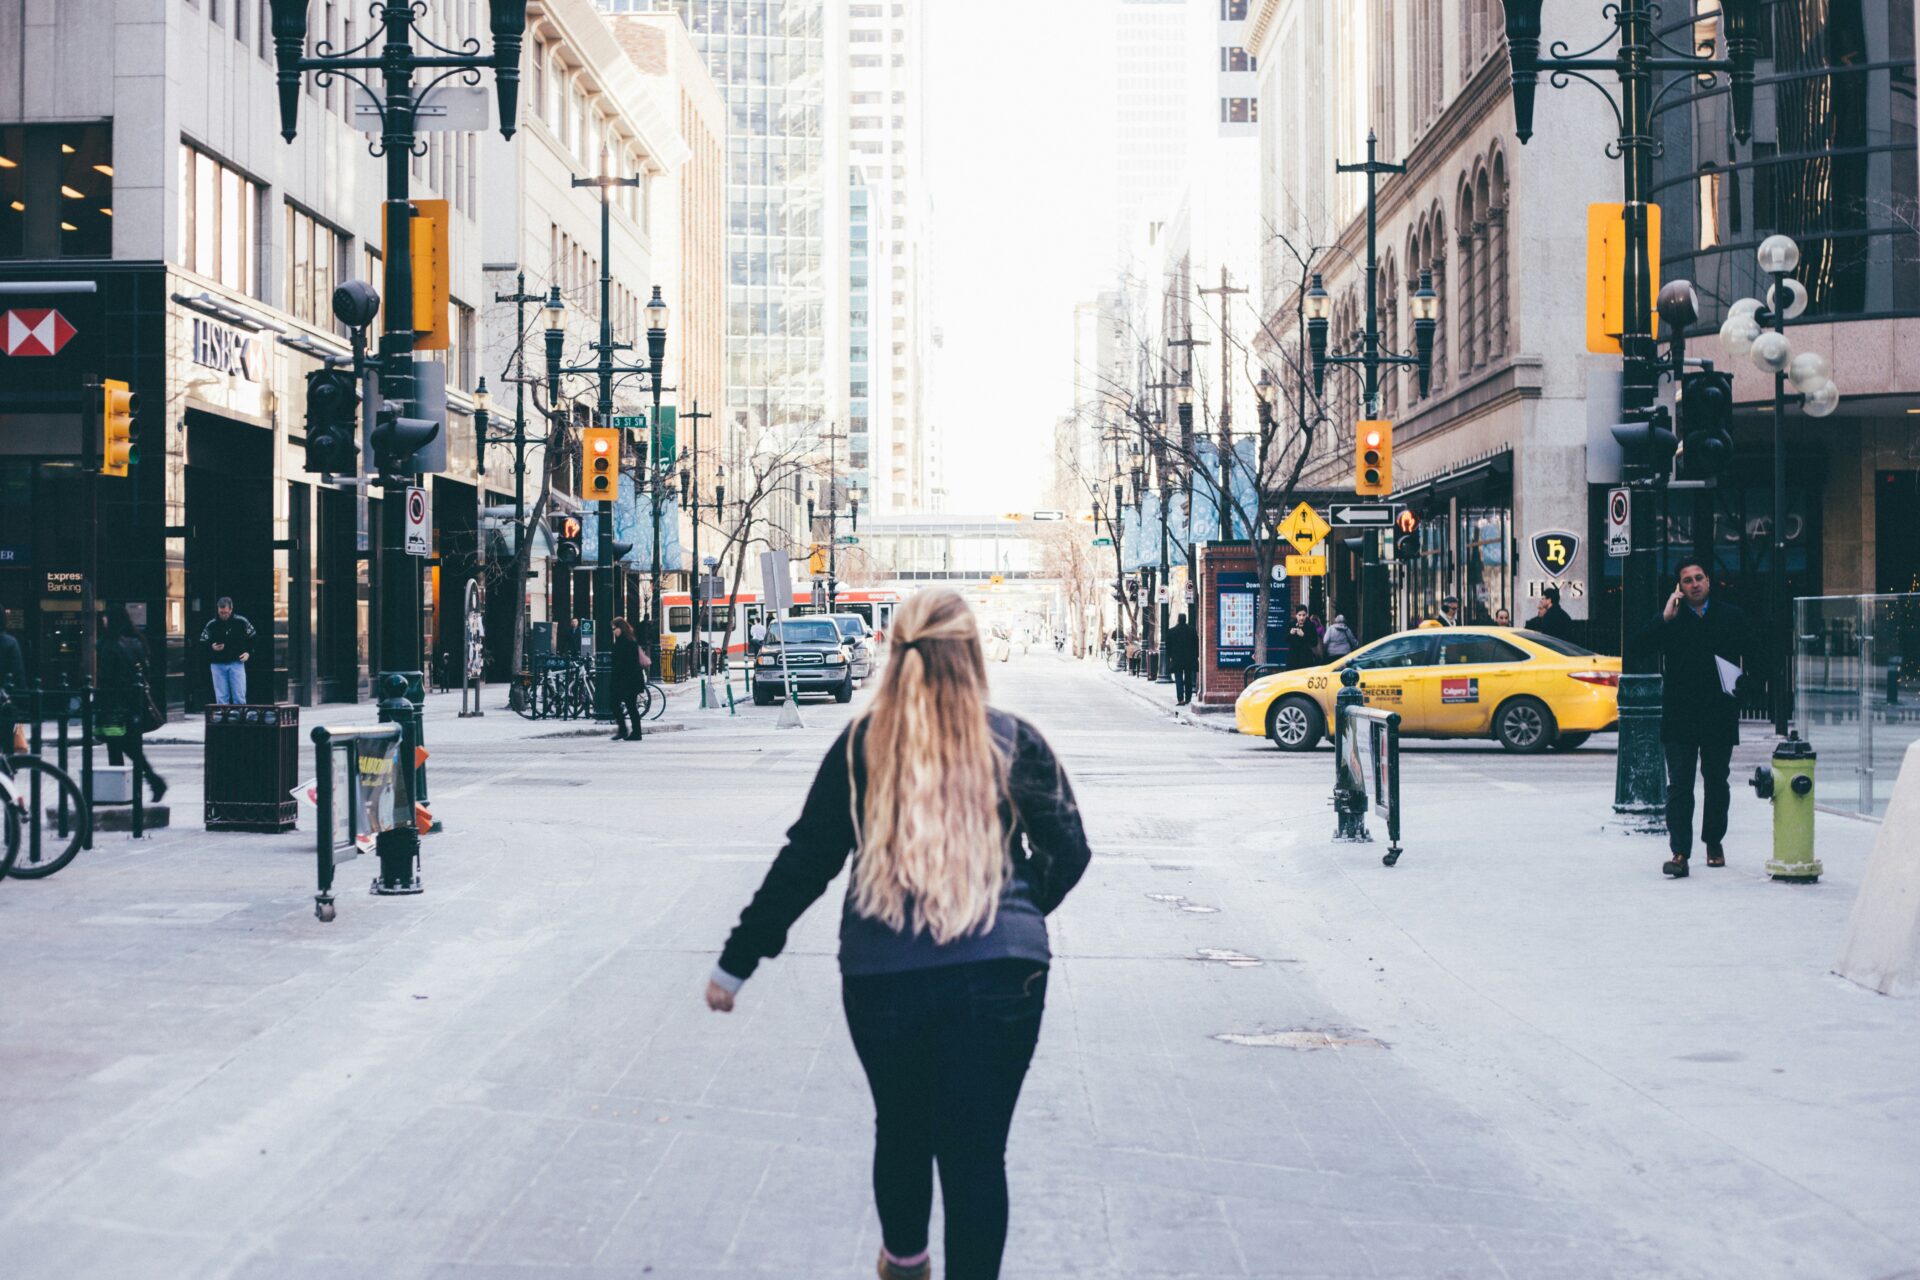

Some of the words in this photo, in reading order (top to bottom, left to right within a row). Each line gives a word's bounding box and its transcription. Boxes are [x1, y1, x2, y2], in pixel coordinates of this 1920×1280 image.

[192, 317, 242, 377] HSBC
[615, 418, 621, 427] 3
[624, 418, 631, 427] ST
[635, 418, 644, 427] SW
[0, 550, 14, 560] ER
[1298, 565, 1312, 573] FILE
[47, 582, 82, 593] Banking
[1529, 581, 1584, 597] HY'S
[1307, 676, 1328, 689] 630
[1362, 688, 1397, 697] CHECKER
[1443, 687, 1467, 696] Calgary
